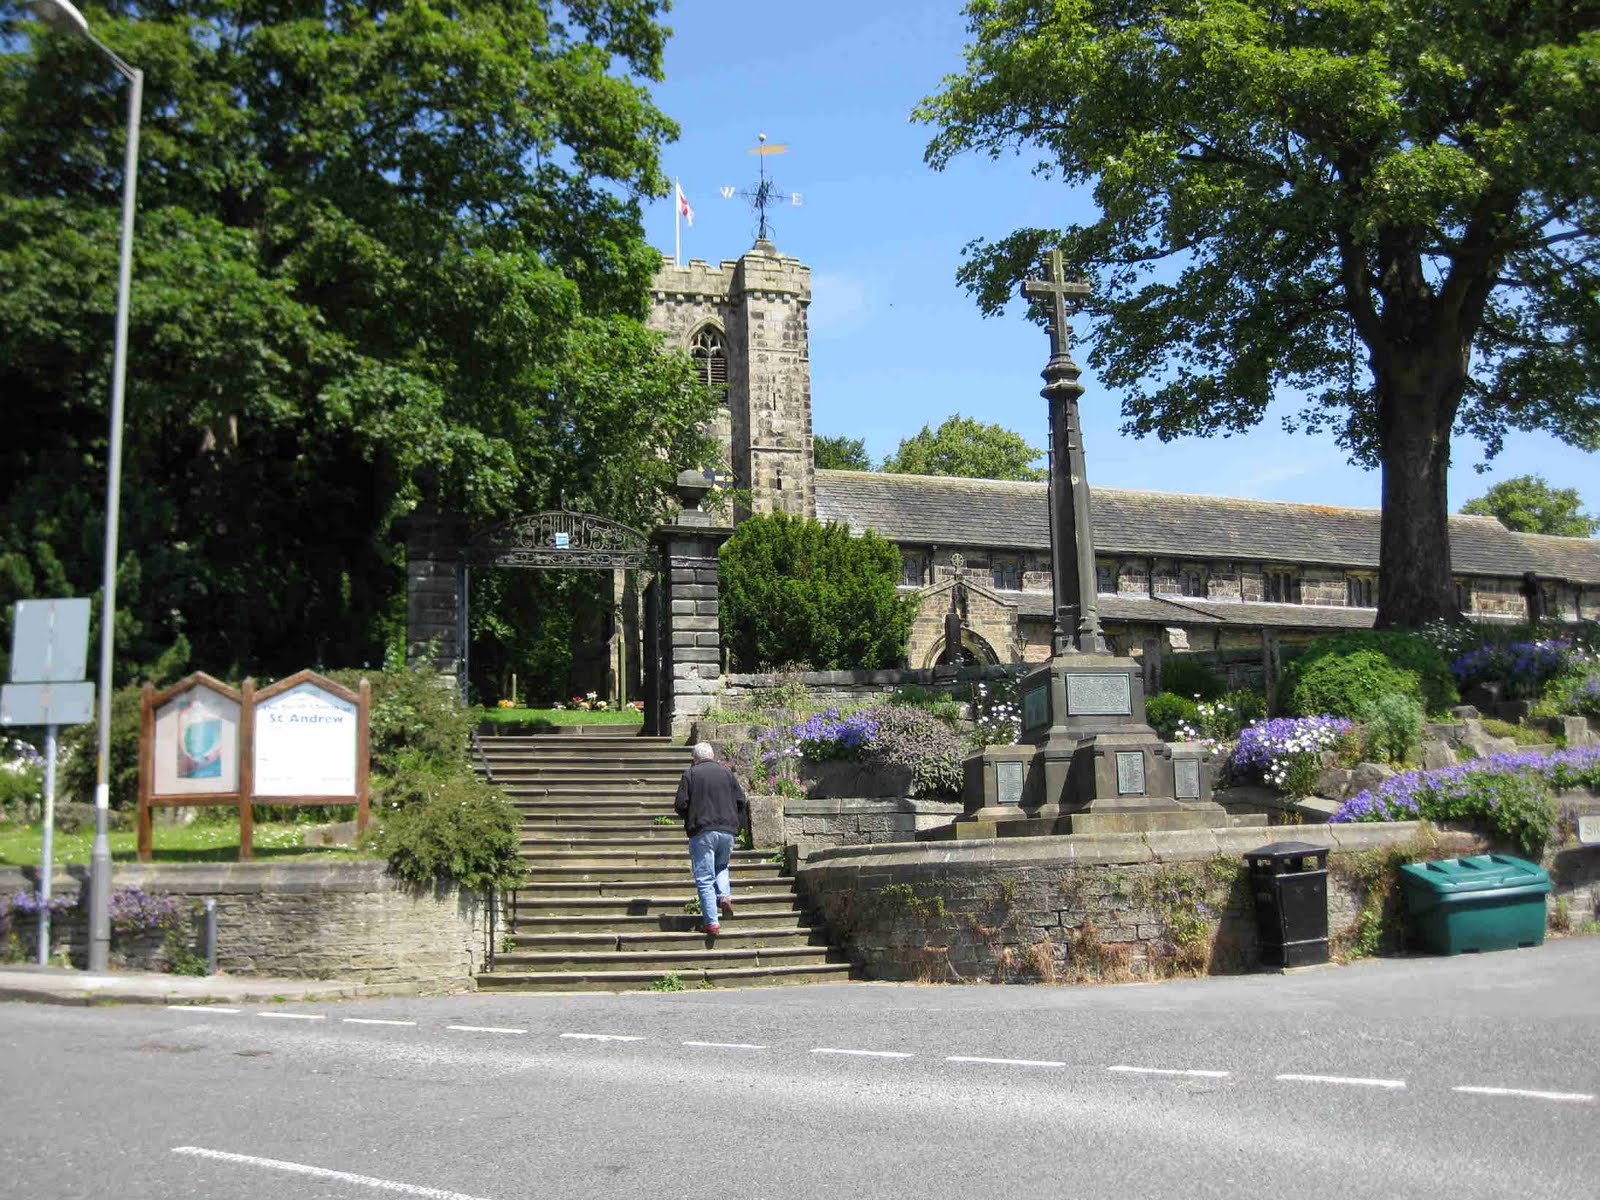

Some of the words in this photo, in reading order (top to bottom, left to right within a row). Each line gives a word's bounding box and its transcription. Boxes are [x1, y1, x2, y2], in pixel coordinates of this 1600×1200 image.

[720, 187, 736, 199] W
[792, 193, 803, 206] E
[269, 713, 283, 723] St
[290, 713, 343, 724] Andrew
